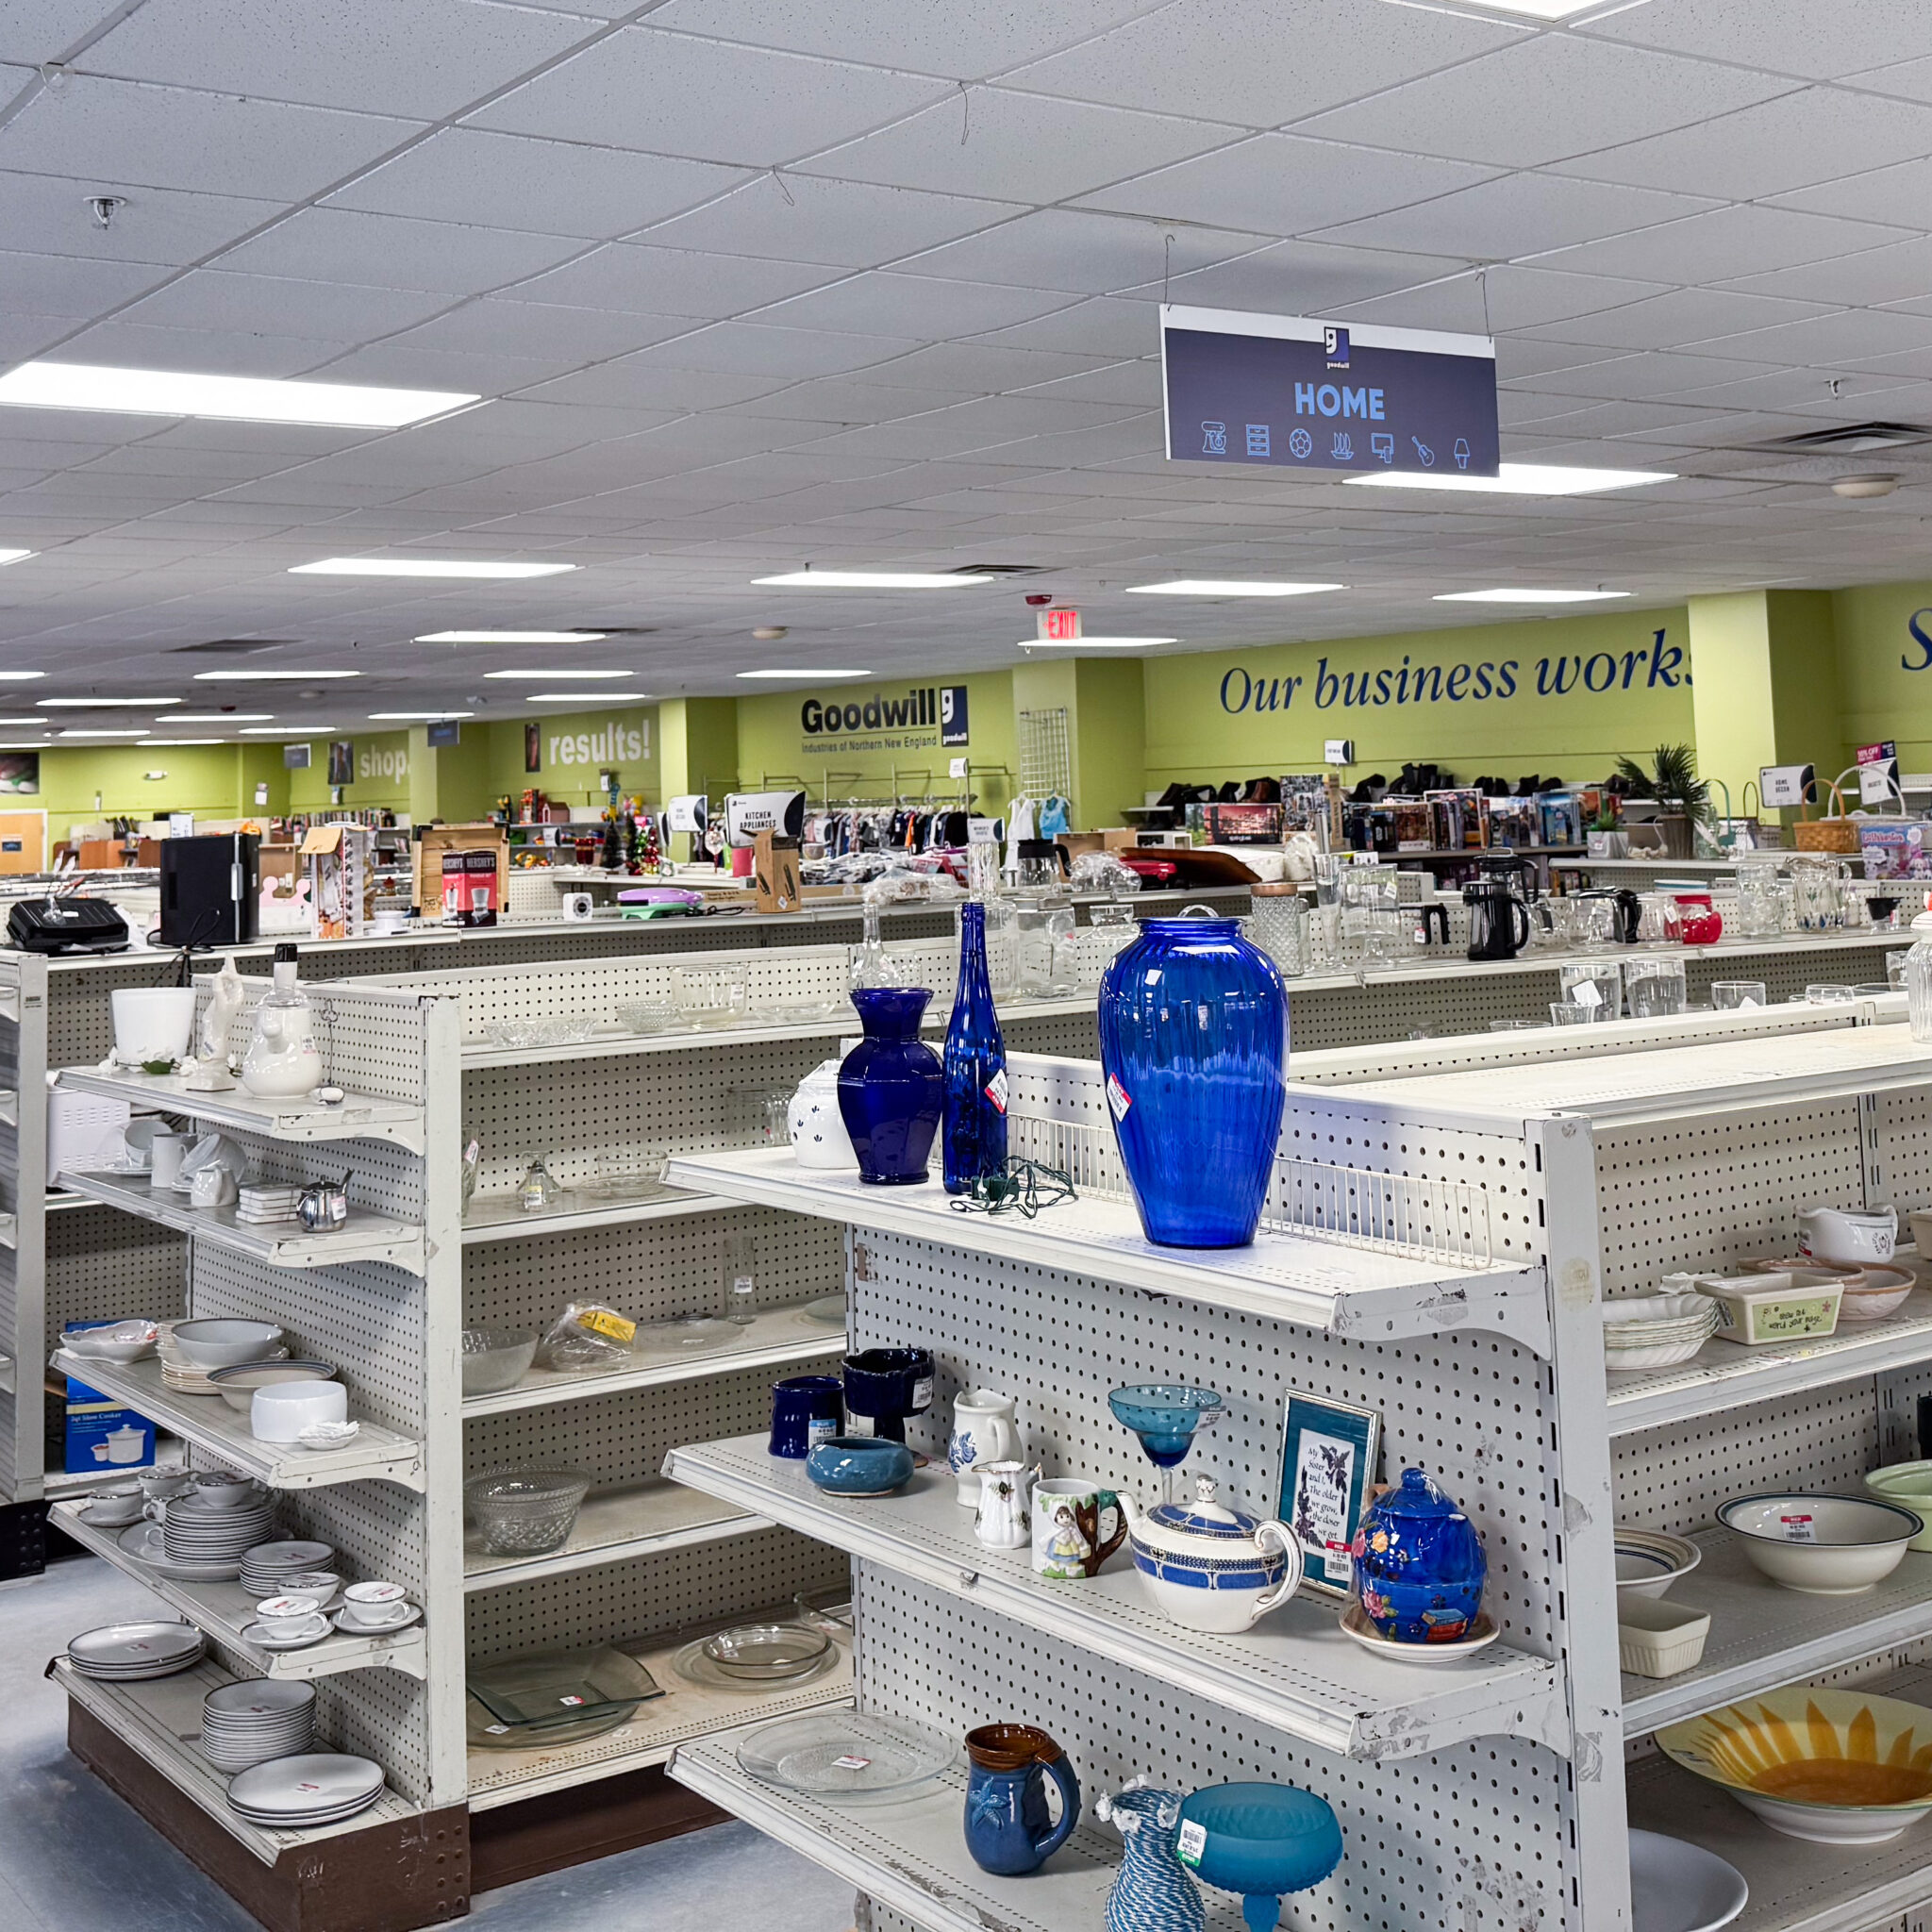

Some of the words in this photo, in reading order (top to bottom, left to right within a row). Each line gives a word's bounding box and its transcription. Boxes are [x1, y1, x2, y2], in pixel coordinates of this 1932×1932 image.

[1294, 382, 1386, 420] HOME
[1048, 610, 1077, 640] EXIT
[1220, 667, 1303, 714] Our
[1315, 655, 1519, 709] business
[802, 689, 936, 733] Goodwill
[550, 719, 651, 765] results!
[803, 742, 838, 753] Industries
[840, 741, 847, 752] of
[849, 739, 883, 751] Northern
[885, 738, 902, 748] New
[904, 736, 937, 750] England
[740, 820, 776, 829] APPLIANCES
[466, 857, 495, 868] HERSHEY'S
[1308, 1447, 1318, 1459] My
[1308, 1459, 1324, 1471] Sister
[1309, 1474, 1321, 1483] and
[1310, 1485, 1321, 1496] The
[1322, 1490, 1339, 1501] older
[1312, 1511, 1322, 1522] the
[1323, 1515, 1340, 1526] closer
